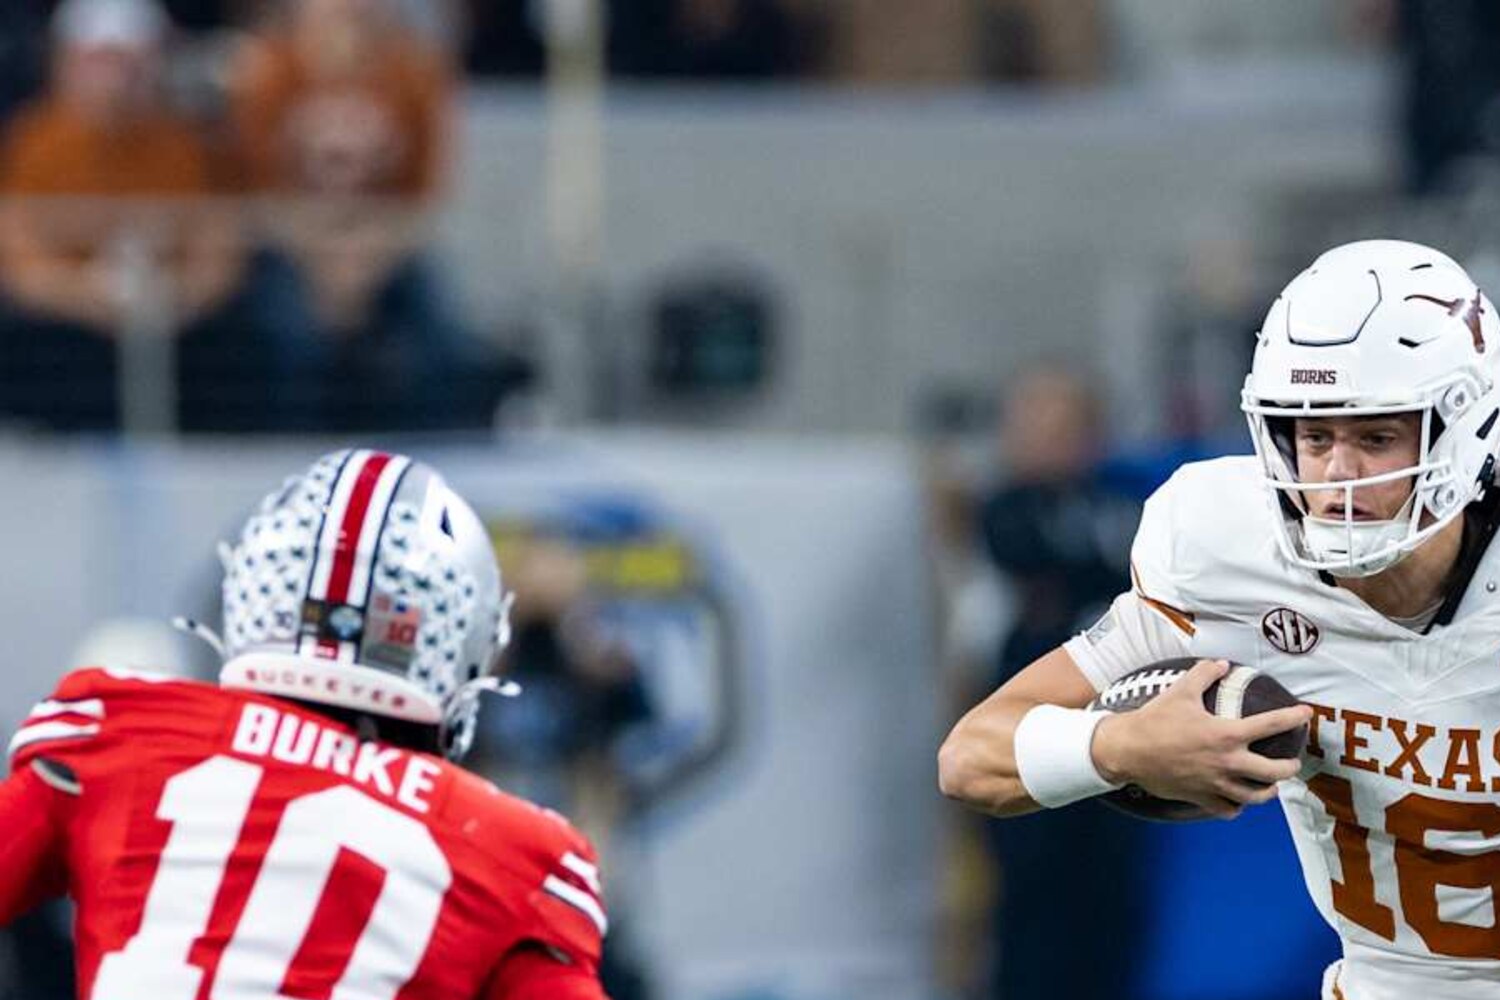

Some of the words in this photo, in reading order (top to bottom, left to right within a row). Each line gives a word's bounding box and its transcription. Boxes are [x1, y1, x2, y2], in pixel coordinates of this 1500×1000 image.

[1291, 369, 1337, 385] HORNS
[1264, 609, 1318, 653] SEC
[231, 701, 442, 814] BURKE
